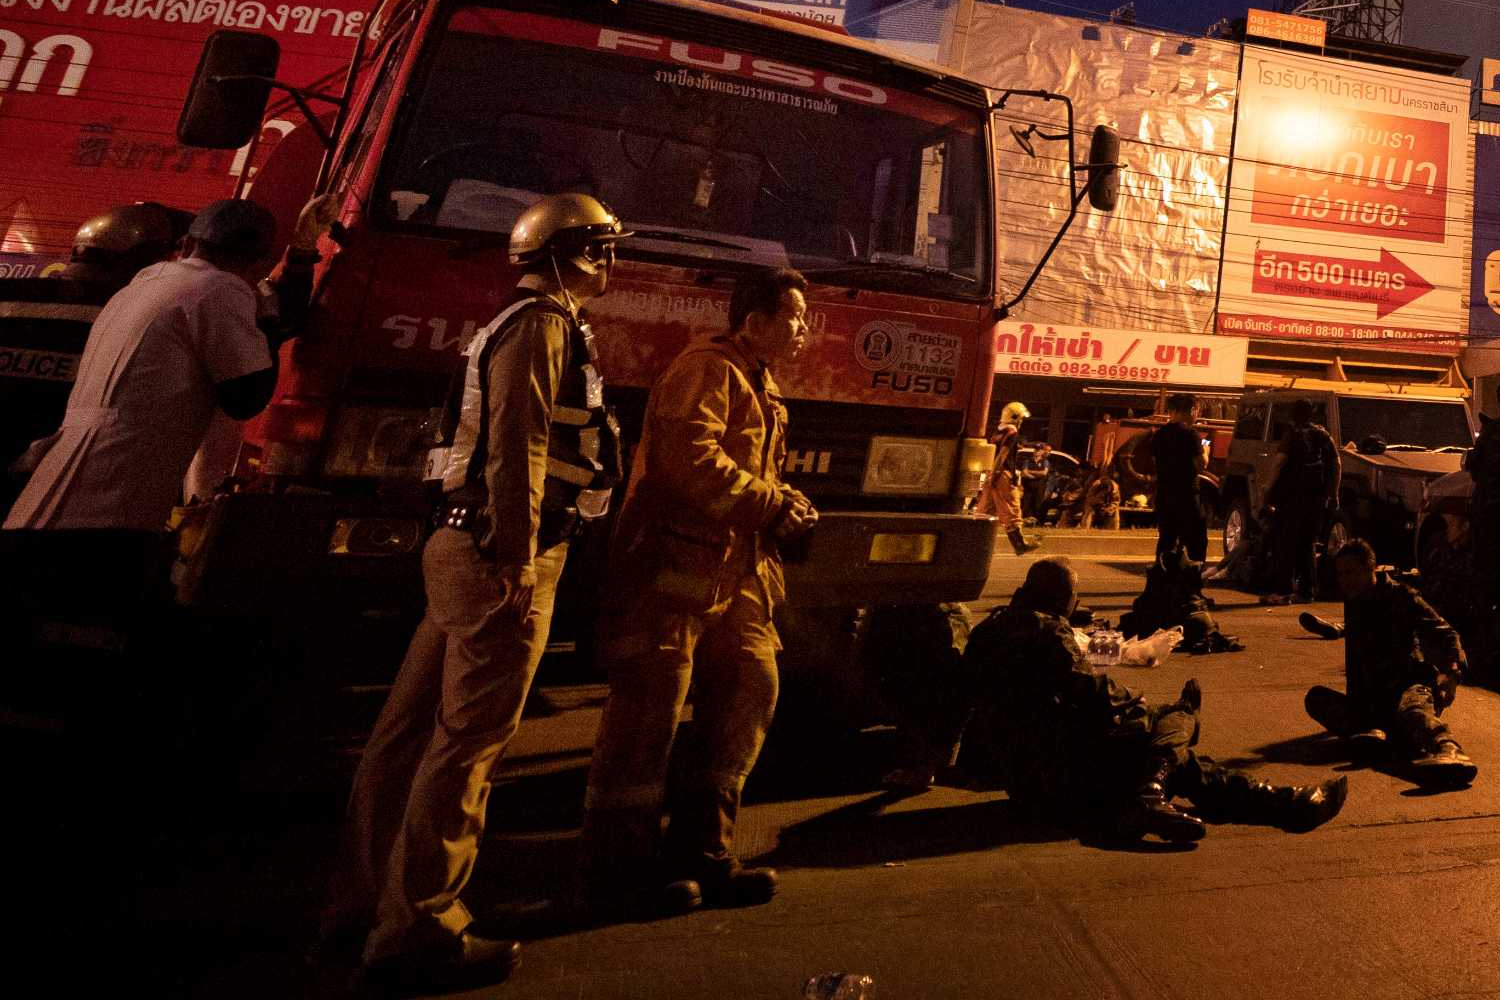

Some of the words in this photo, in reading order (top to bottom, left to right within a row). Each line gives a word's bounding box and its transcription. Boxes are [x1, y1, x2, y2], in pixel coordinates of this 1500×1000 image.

[597, 28, 887, 105] FUSO
[1289, 189, 1409, 227] กว่าเยอะ
[1259, 254, 1293, 280] อีก
[1297, 261, 1344, 285] 500
[1350, 267, 1406, 291] เมตร
[1223, 317, 1243, 330] เปิด
[1245, 318, 1273, 332] จันทร์
[1315, 325, 1344, 338] 08:00
[904, 345, 954, 366] 1132
[1154, 344, 1211, 367] ขาย
[1008, 356, 1053, 373] ติดต่อ
[1058, 361, 1170, 380] 082-8696937
[872, 371, 953, 395] FUSO
